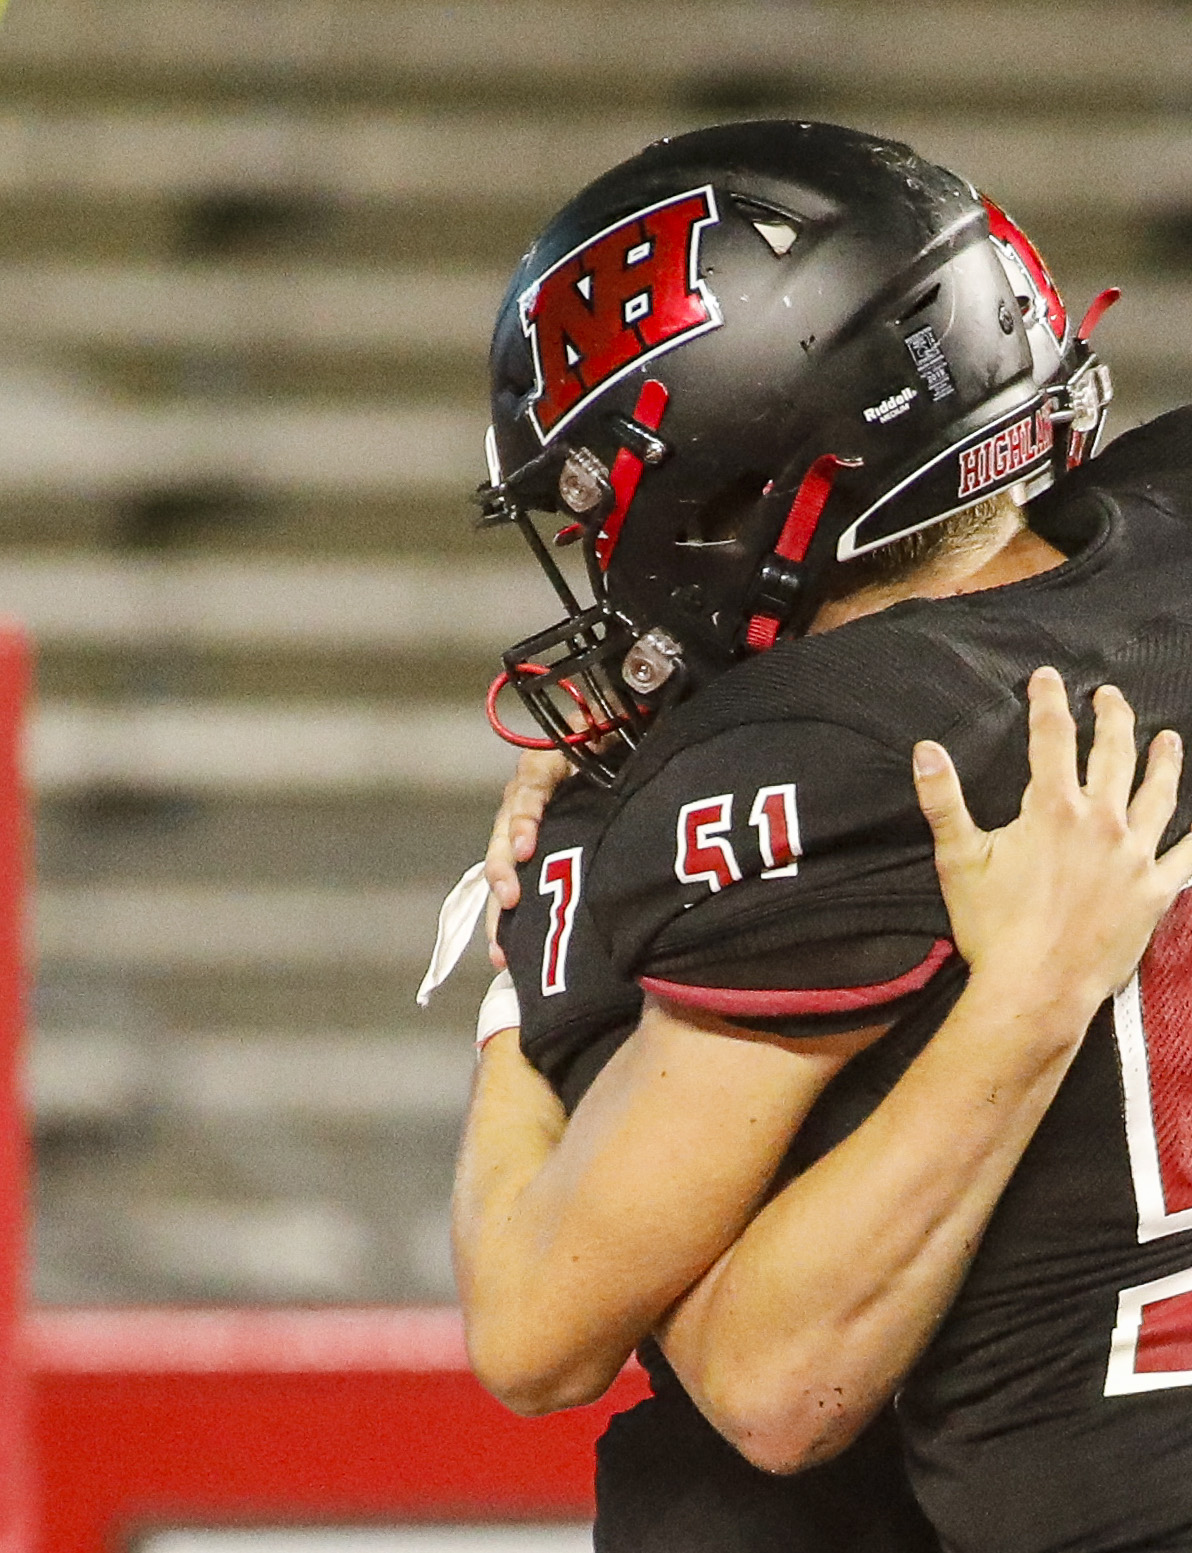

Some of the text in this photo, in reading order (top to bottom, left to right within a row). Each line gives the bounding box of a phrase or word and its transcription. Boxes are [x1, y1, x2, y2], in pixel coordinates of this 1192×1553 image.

[518, 184, 724, 446] NH
[863, 387, 917, 422] Riddell
[674, 783, 803, 908] 51
